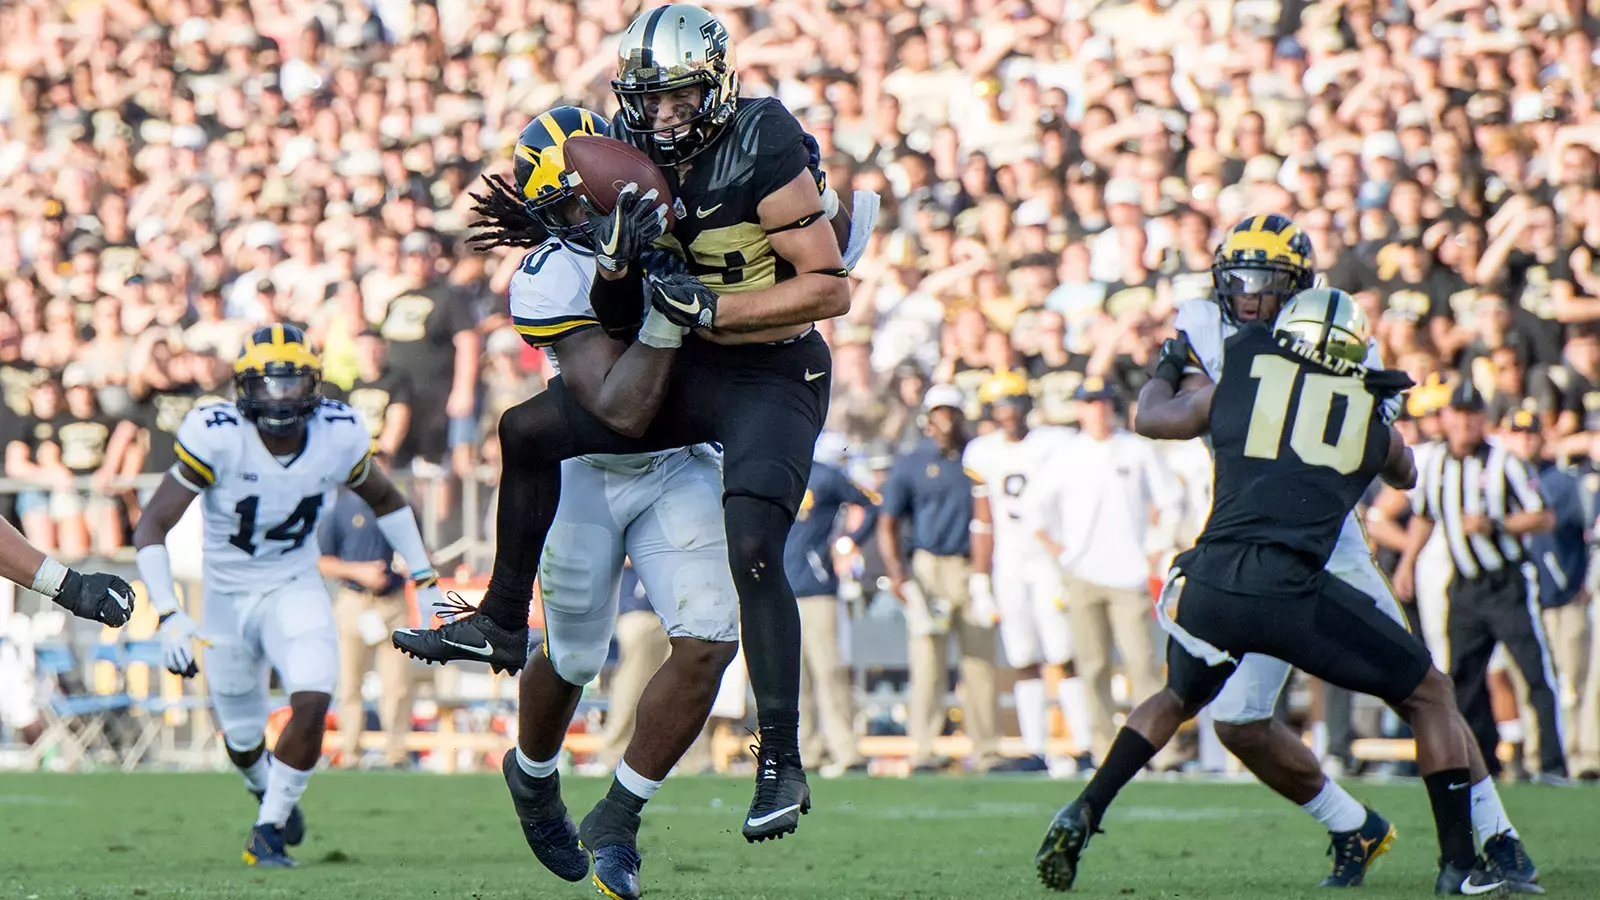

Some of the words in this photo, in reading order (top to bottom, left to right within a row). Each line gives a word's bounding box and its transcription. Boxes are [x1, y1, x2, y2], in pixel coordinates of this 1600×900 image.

[518, 240, 562, 275] 0
[1243, 353, 1375, 476] 10
[228, 492, 326, 557] 14
